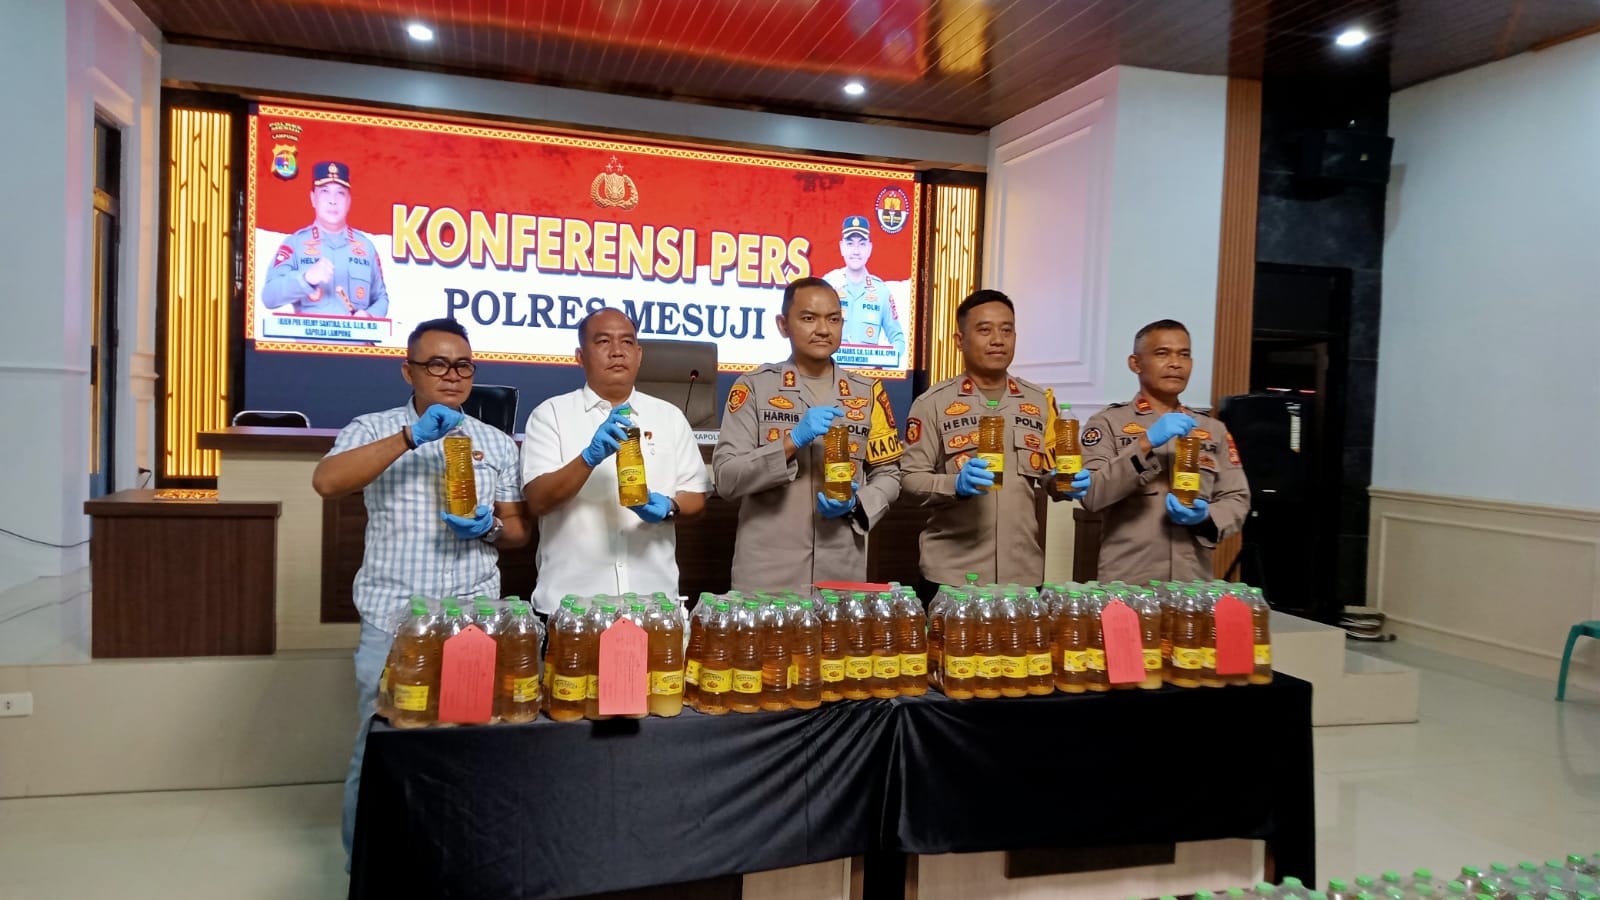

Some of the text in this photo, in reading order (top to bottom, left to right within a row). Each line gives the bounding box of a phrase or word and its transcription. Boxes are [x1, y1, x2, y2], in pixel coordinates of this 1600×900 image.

[391, 203, 811, 286] KONFERENSI PERS
[622, 299, 766, 340] MESUJI
[763, 411, 800, 423] HARRIS
[943, 416, 978, 431] HERU
[1015, 416, 1043, 431] POLRI
[847, 425, 870, 436] OLRI
[869, 434, 900, 458] KA OP
